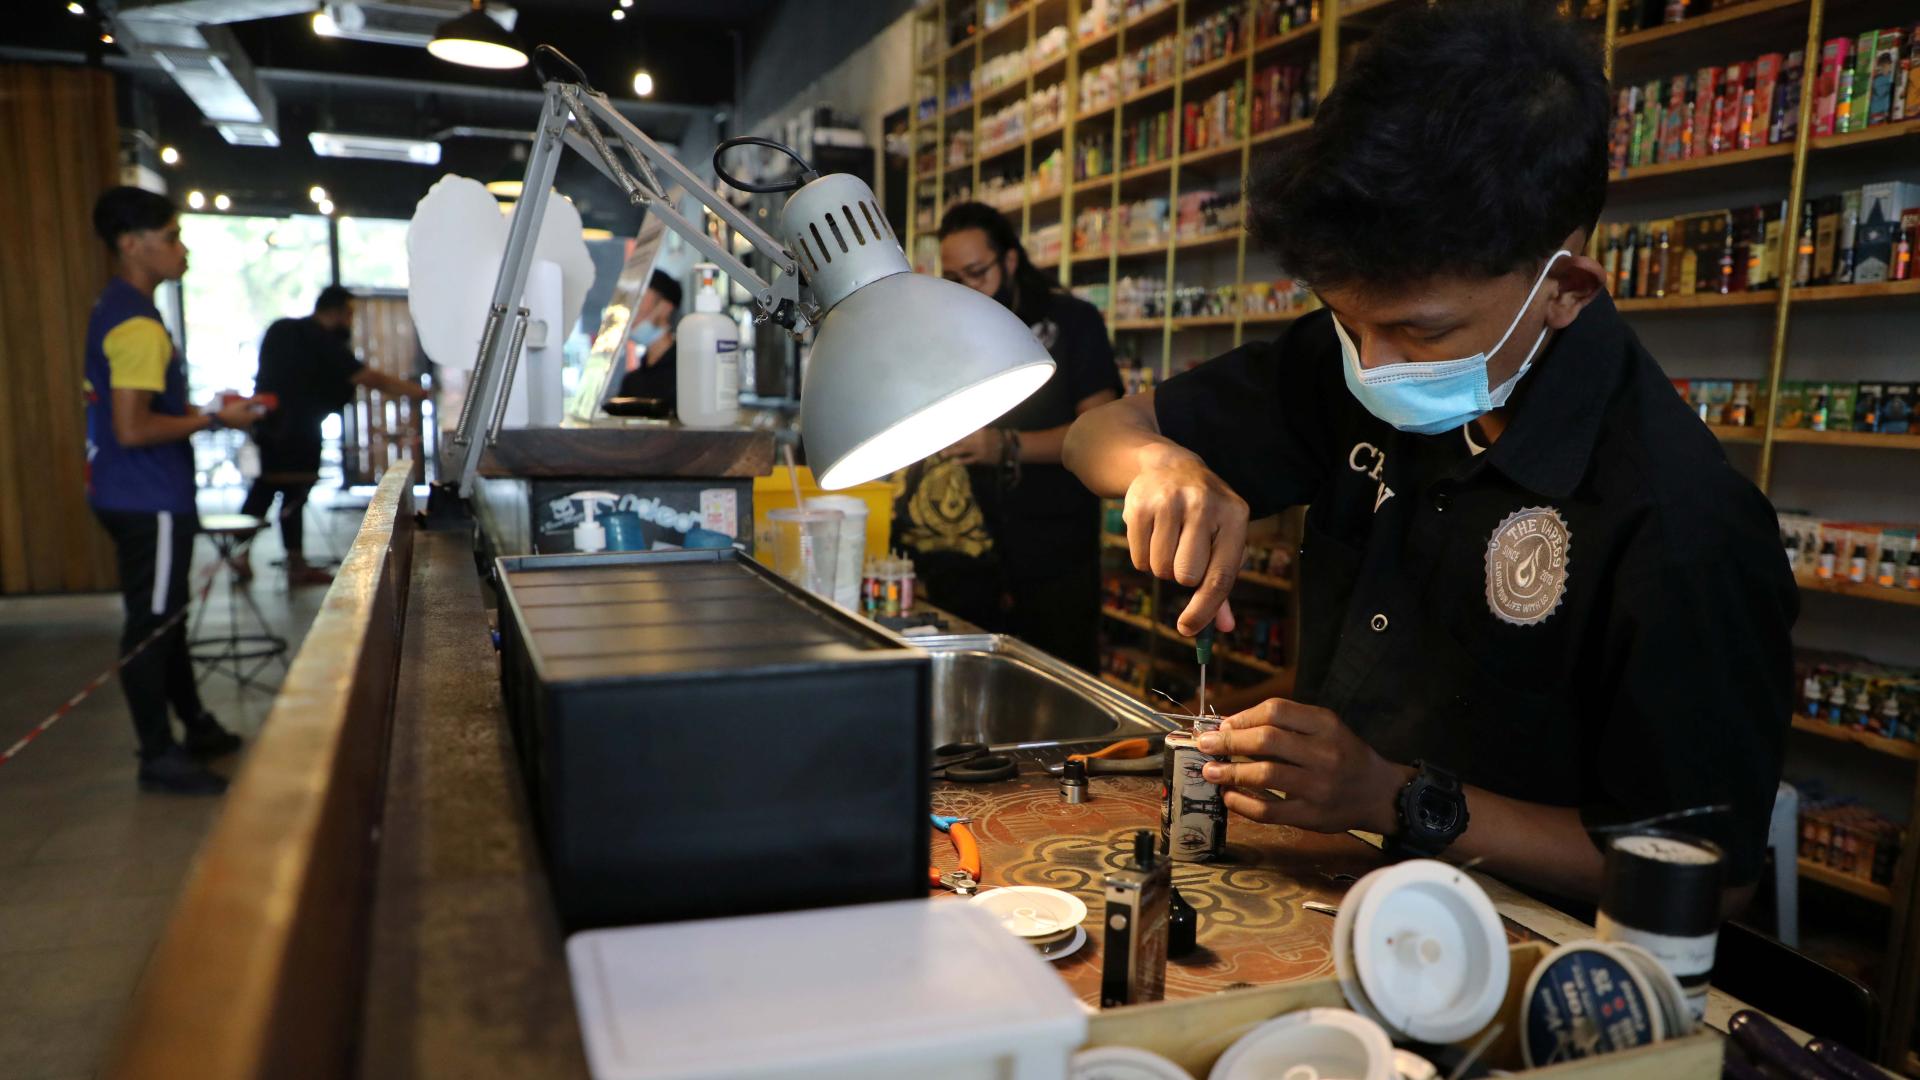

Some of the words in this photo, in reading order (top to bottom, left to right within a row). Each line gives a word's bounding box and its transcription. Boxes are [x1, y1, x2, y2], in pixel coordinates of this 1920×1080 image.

[1506, 519, 1537, 540] THE
[1502, 545, 1520, 562] SINCE
[1505, 600, 1522, 611] LIFE
